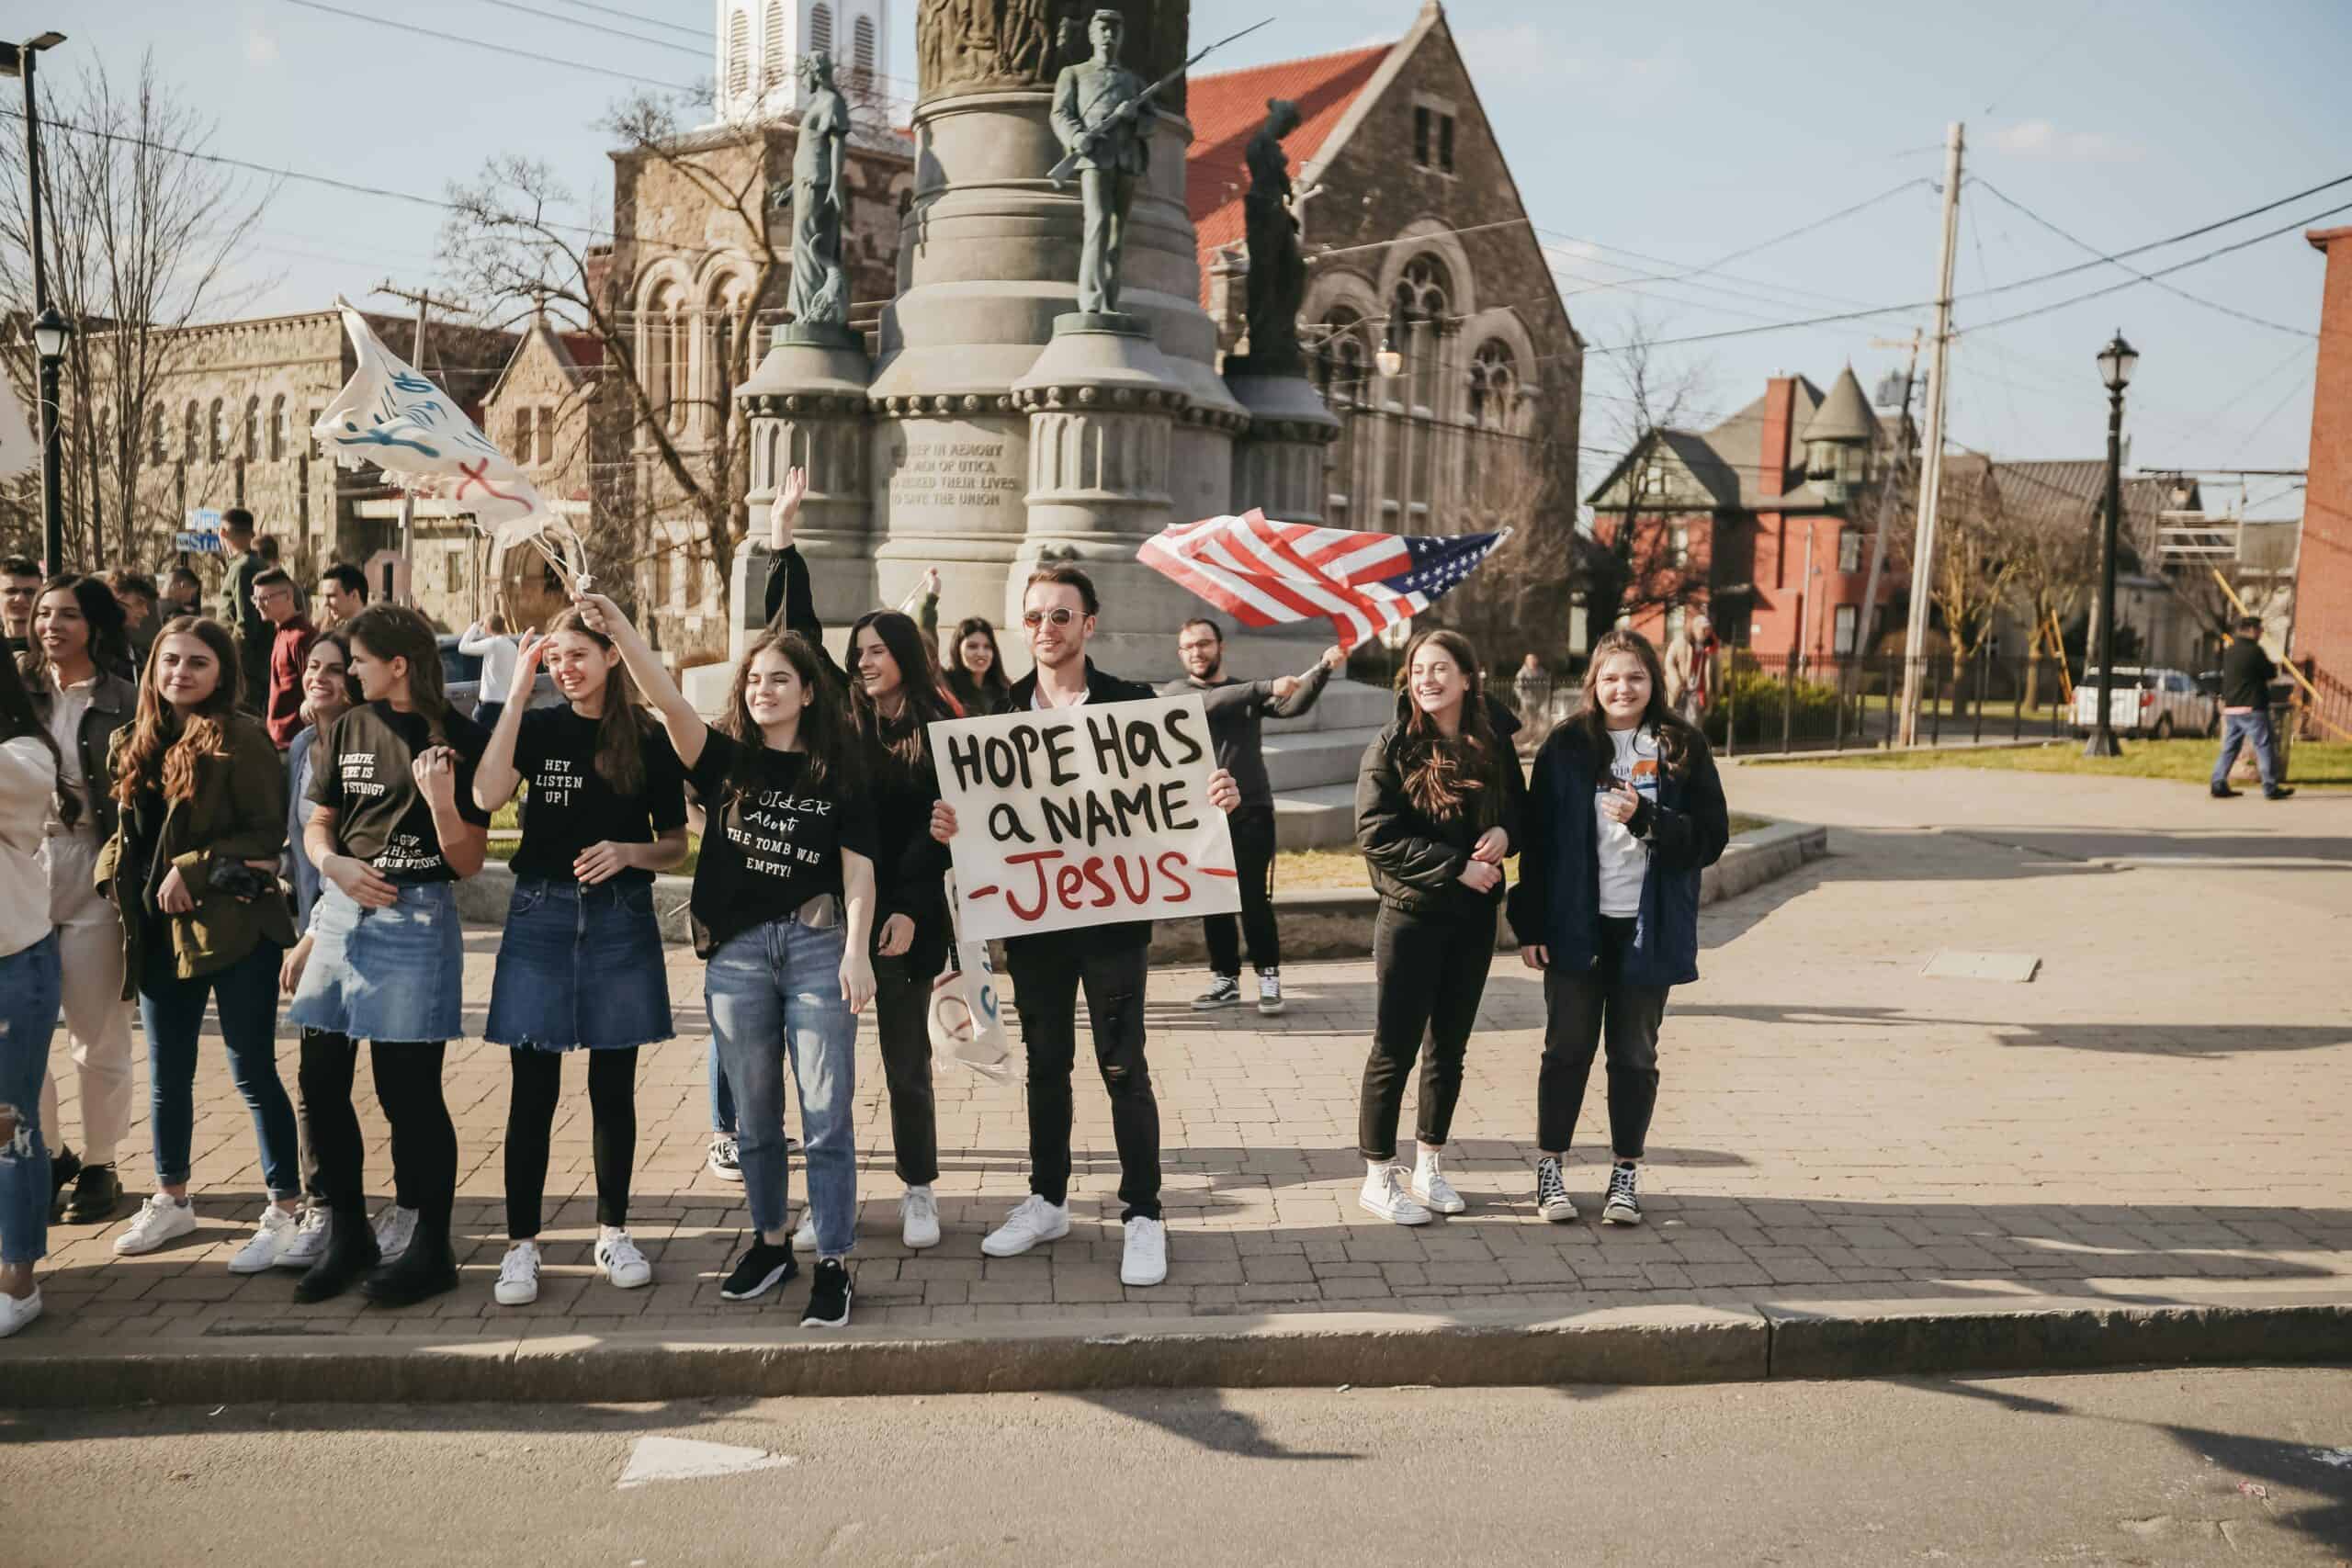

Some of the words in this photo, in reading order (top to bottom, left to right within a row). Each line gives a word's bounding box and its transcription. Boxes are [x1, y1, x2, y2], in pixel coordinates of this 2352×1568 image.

[958, 460, 997, 473] UTICA
[545, 759, 571, 773] HEY
[948, 724, 1080, 792] HOPE
[535, 774, 583, 788] LISTEN
[1040, 780, 1199, 847] NAME
[727, 827, 752, 845] THE
[756, 837, 792, 855] TOMB
[797, 848, 820, 864] WAS
[746, 857, 792, 878] EMPTY!
